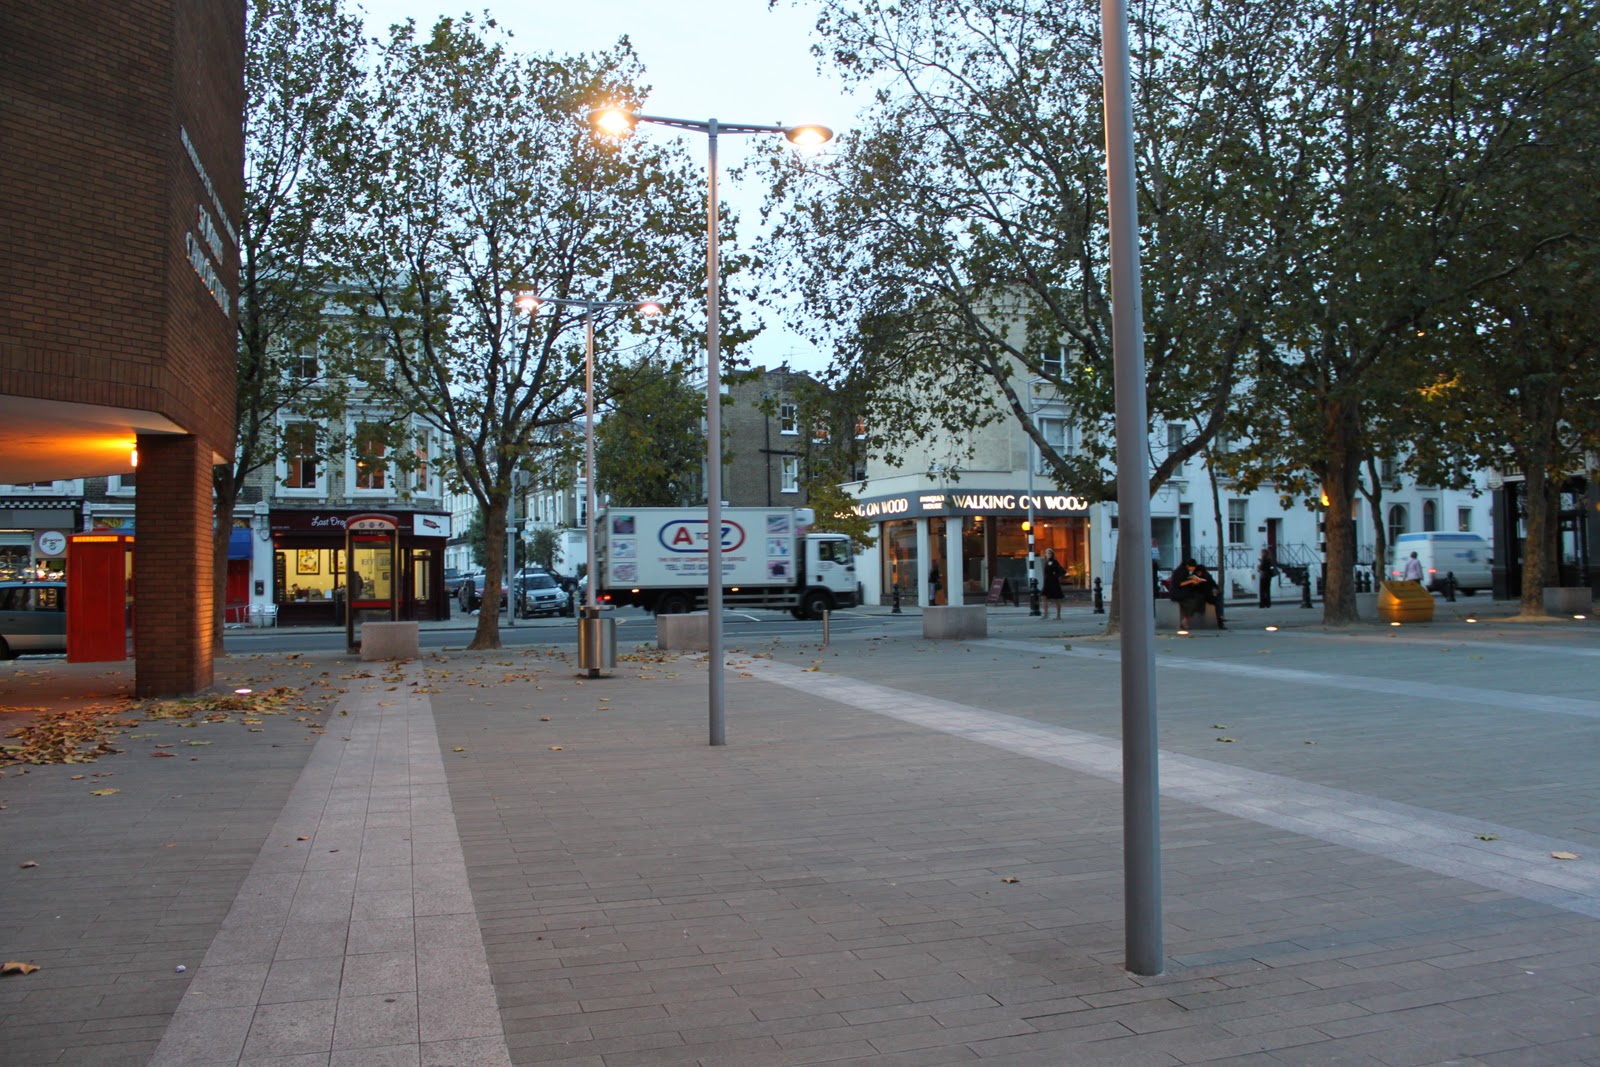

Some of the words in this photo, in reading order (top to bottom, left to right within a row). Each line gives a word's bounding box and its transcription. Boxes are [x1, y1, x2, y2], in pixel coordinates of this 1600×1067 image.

[866, 502, 880, 516] ON
[881, 498, 909, 514] WOOD
[952, 494, 1016, 510] WALKING
[1018, 494, 1042, 510] ON
[311, 515, 329, 526] Last
[672, 527, 693, 545] A
